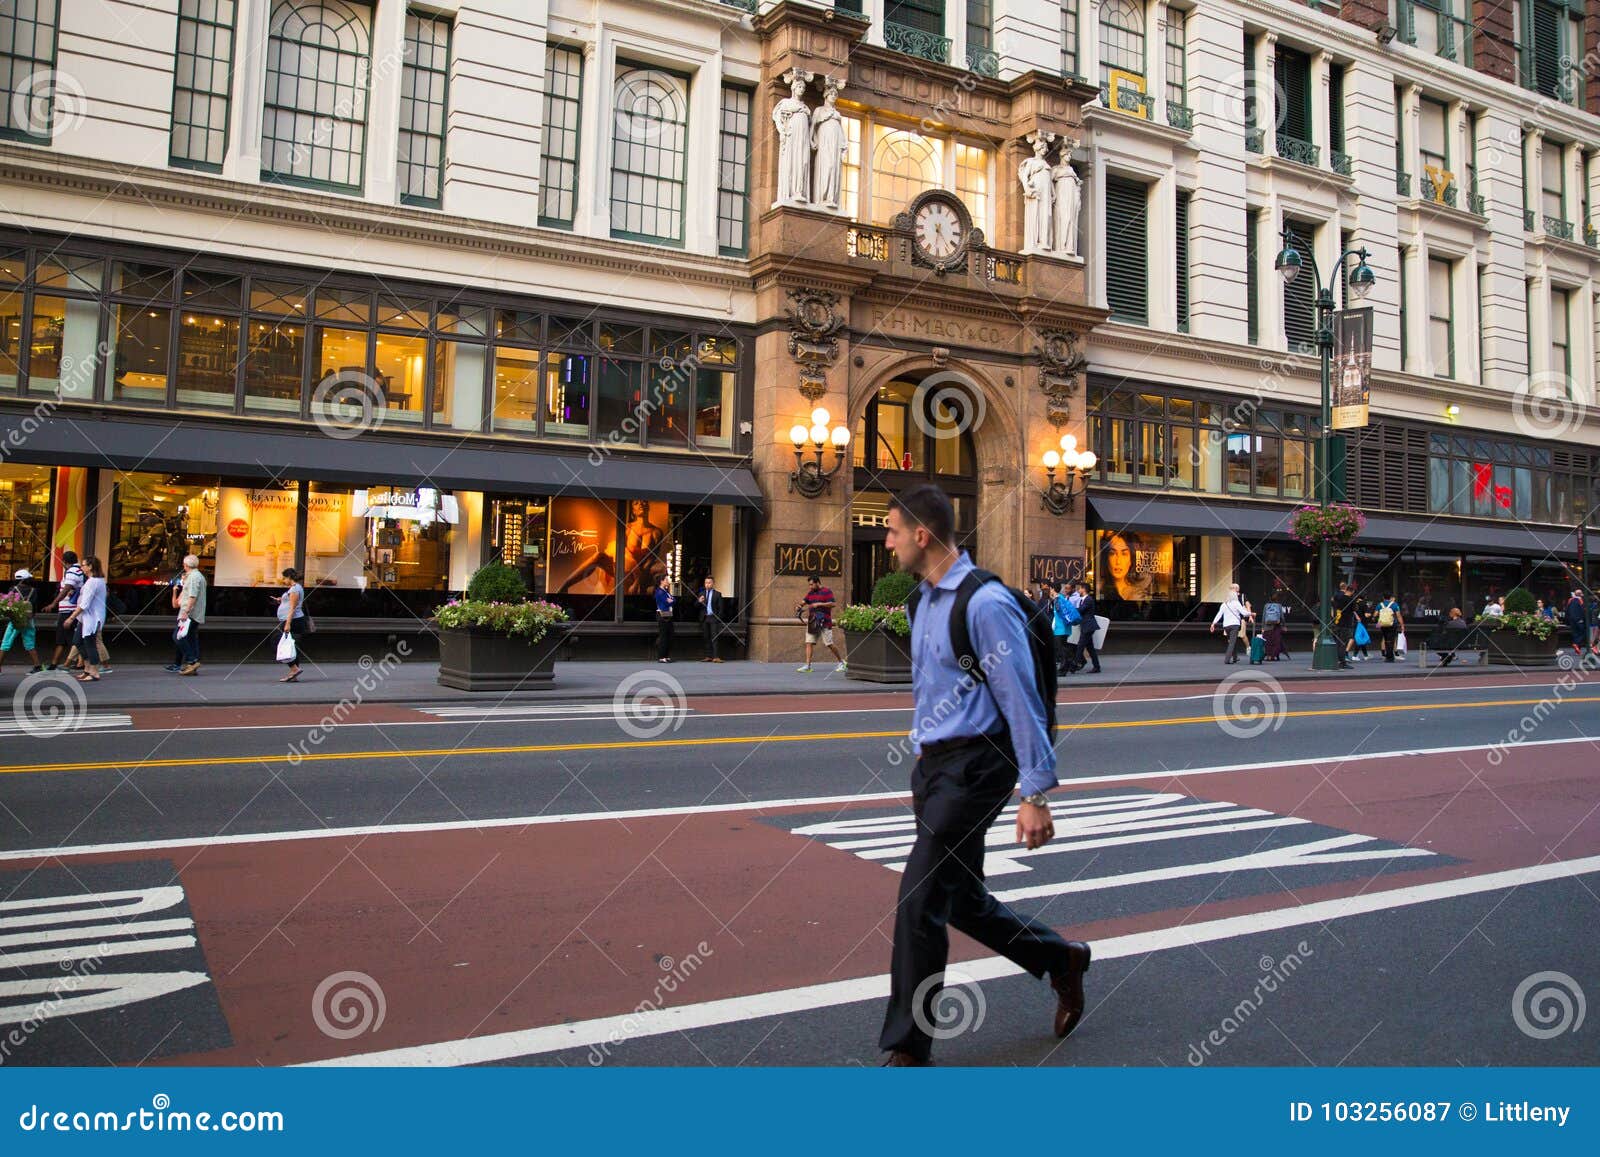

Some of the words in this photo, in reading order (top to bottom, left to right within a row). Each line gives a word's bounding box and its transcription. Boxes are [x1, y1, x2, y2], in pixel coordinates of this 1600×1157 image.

[1109, 69, 1147, 120] C
[1424, 163, 1455, 206] Y
[246, 493, 275, 503] TREAT
[1135, 550, 1170, 561] INSTANT
